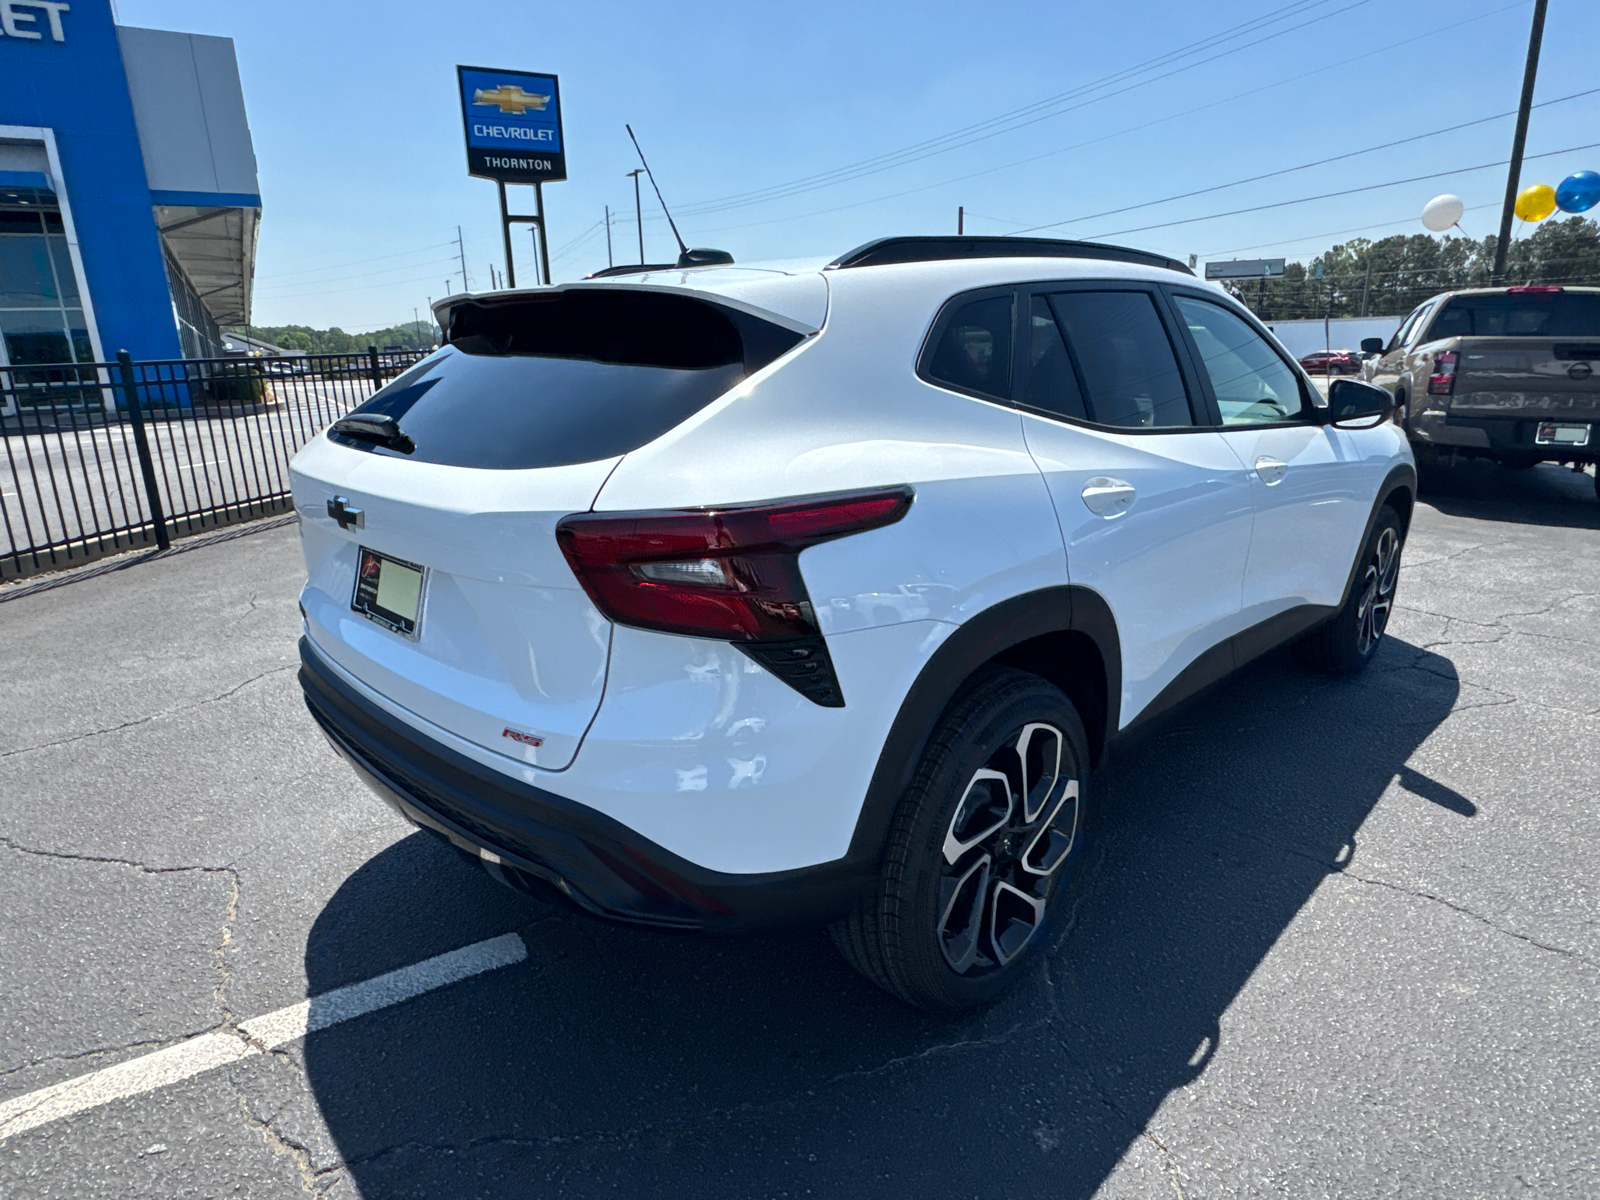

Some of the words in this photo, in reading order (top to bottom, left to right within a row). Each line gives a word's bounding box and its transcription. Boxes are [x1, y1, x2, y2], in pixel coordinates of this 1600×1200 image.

[0, 0, 70, 42] ET
[474, 124, 554, 141] CHEVROLET
[484, 156, 552, 171] THORNTON
[502, 727, 546, 748] RS
